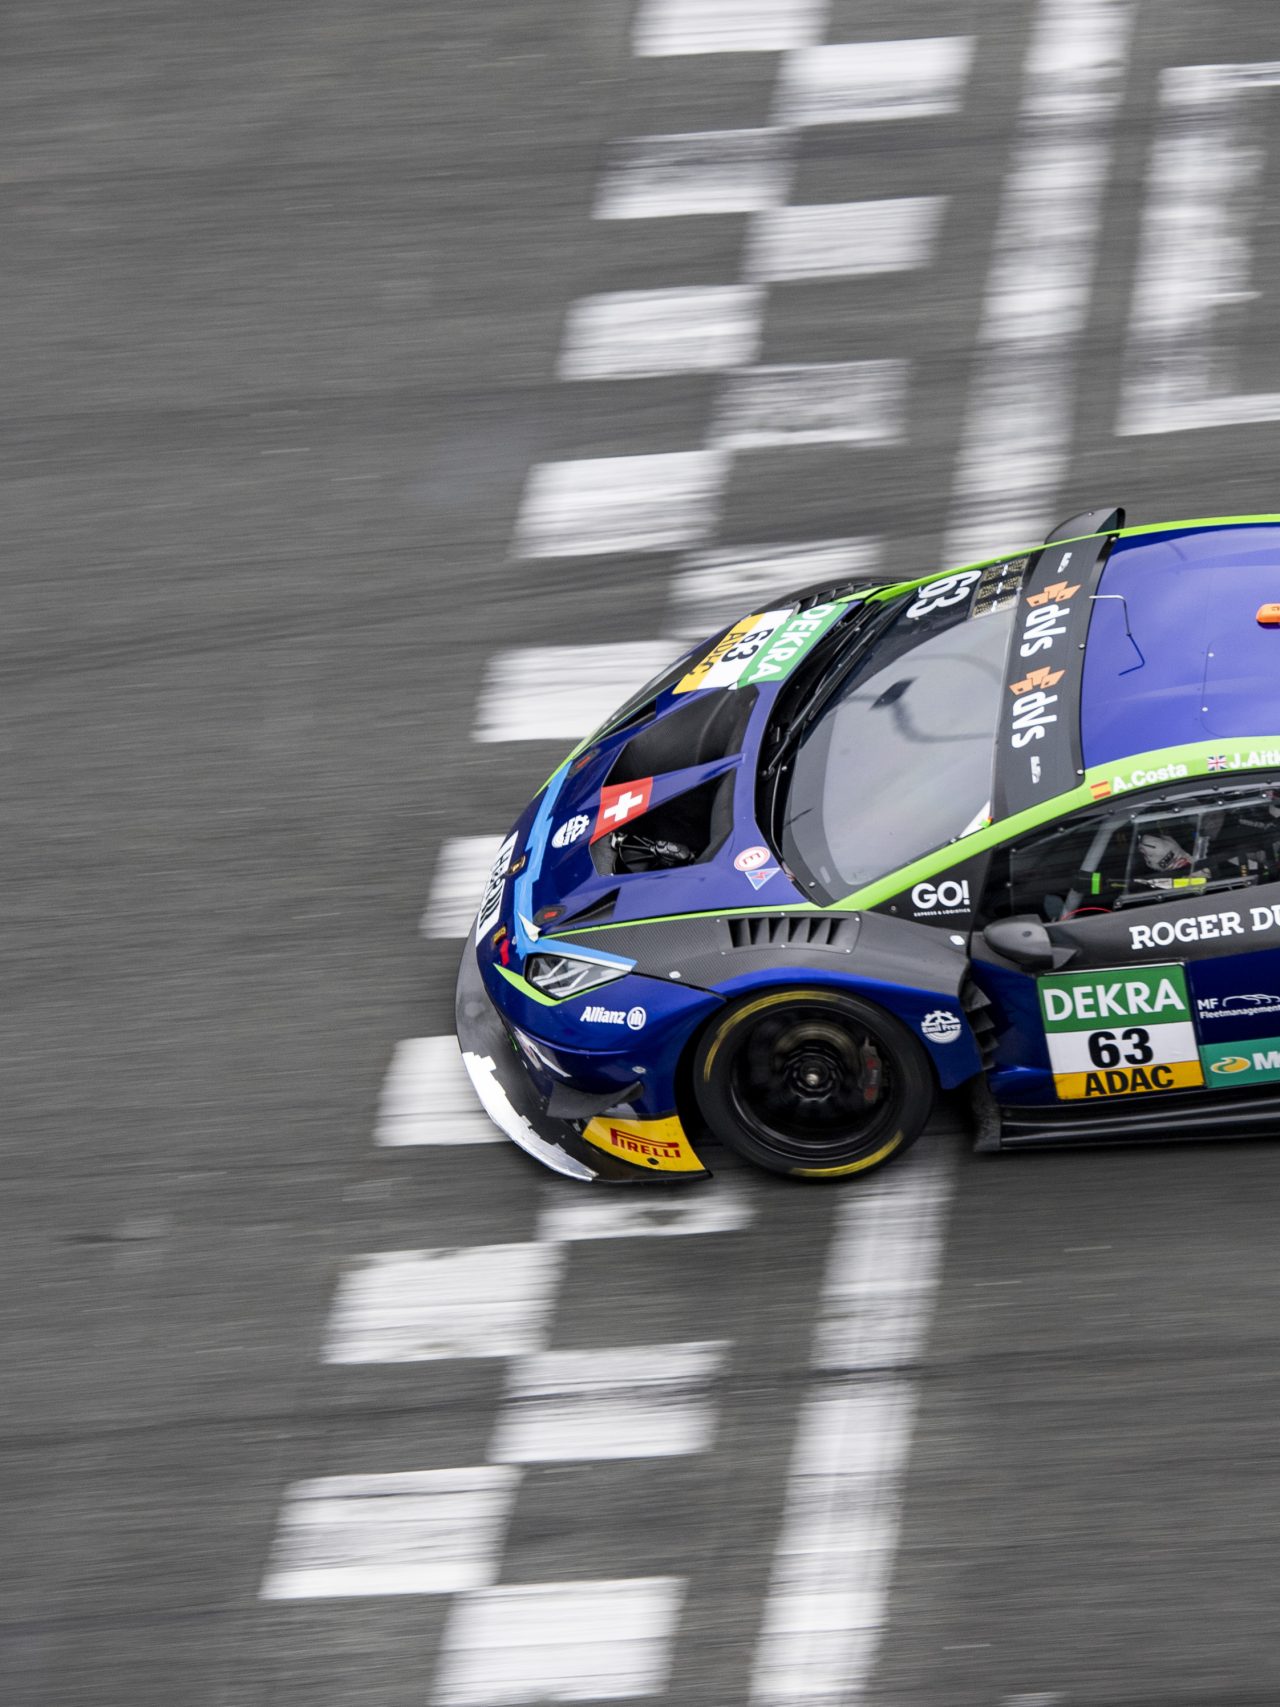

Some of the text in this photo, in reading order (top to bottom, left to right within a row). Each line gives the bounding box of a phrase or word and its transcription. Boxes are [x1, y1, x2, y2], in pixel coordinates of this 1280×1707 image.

[906, 570, 982, 619] 63
[721, 628, 774, 663] 63
[746, 604, 837, 682] DEKRA
[1112, 763, 1188, 793] A.Costa
[911, 880, 970, 909] GO!
[1129, 911, 1244, 950] ROGER
[580, 1006, 626, 1025] Allianz
[1043, 978, 1186, 1021] DEKRA
[1197, 998, 1219, 1010] MF
[1088, 1028, 1154, 1069] 63
[1084, 1065, 1174, 1097] ADAC
[610, 1127, 681, 1159] PIRELLI
